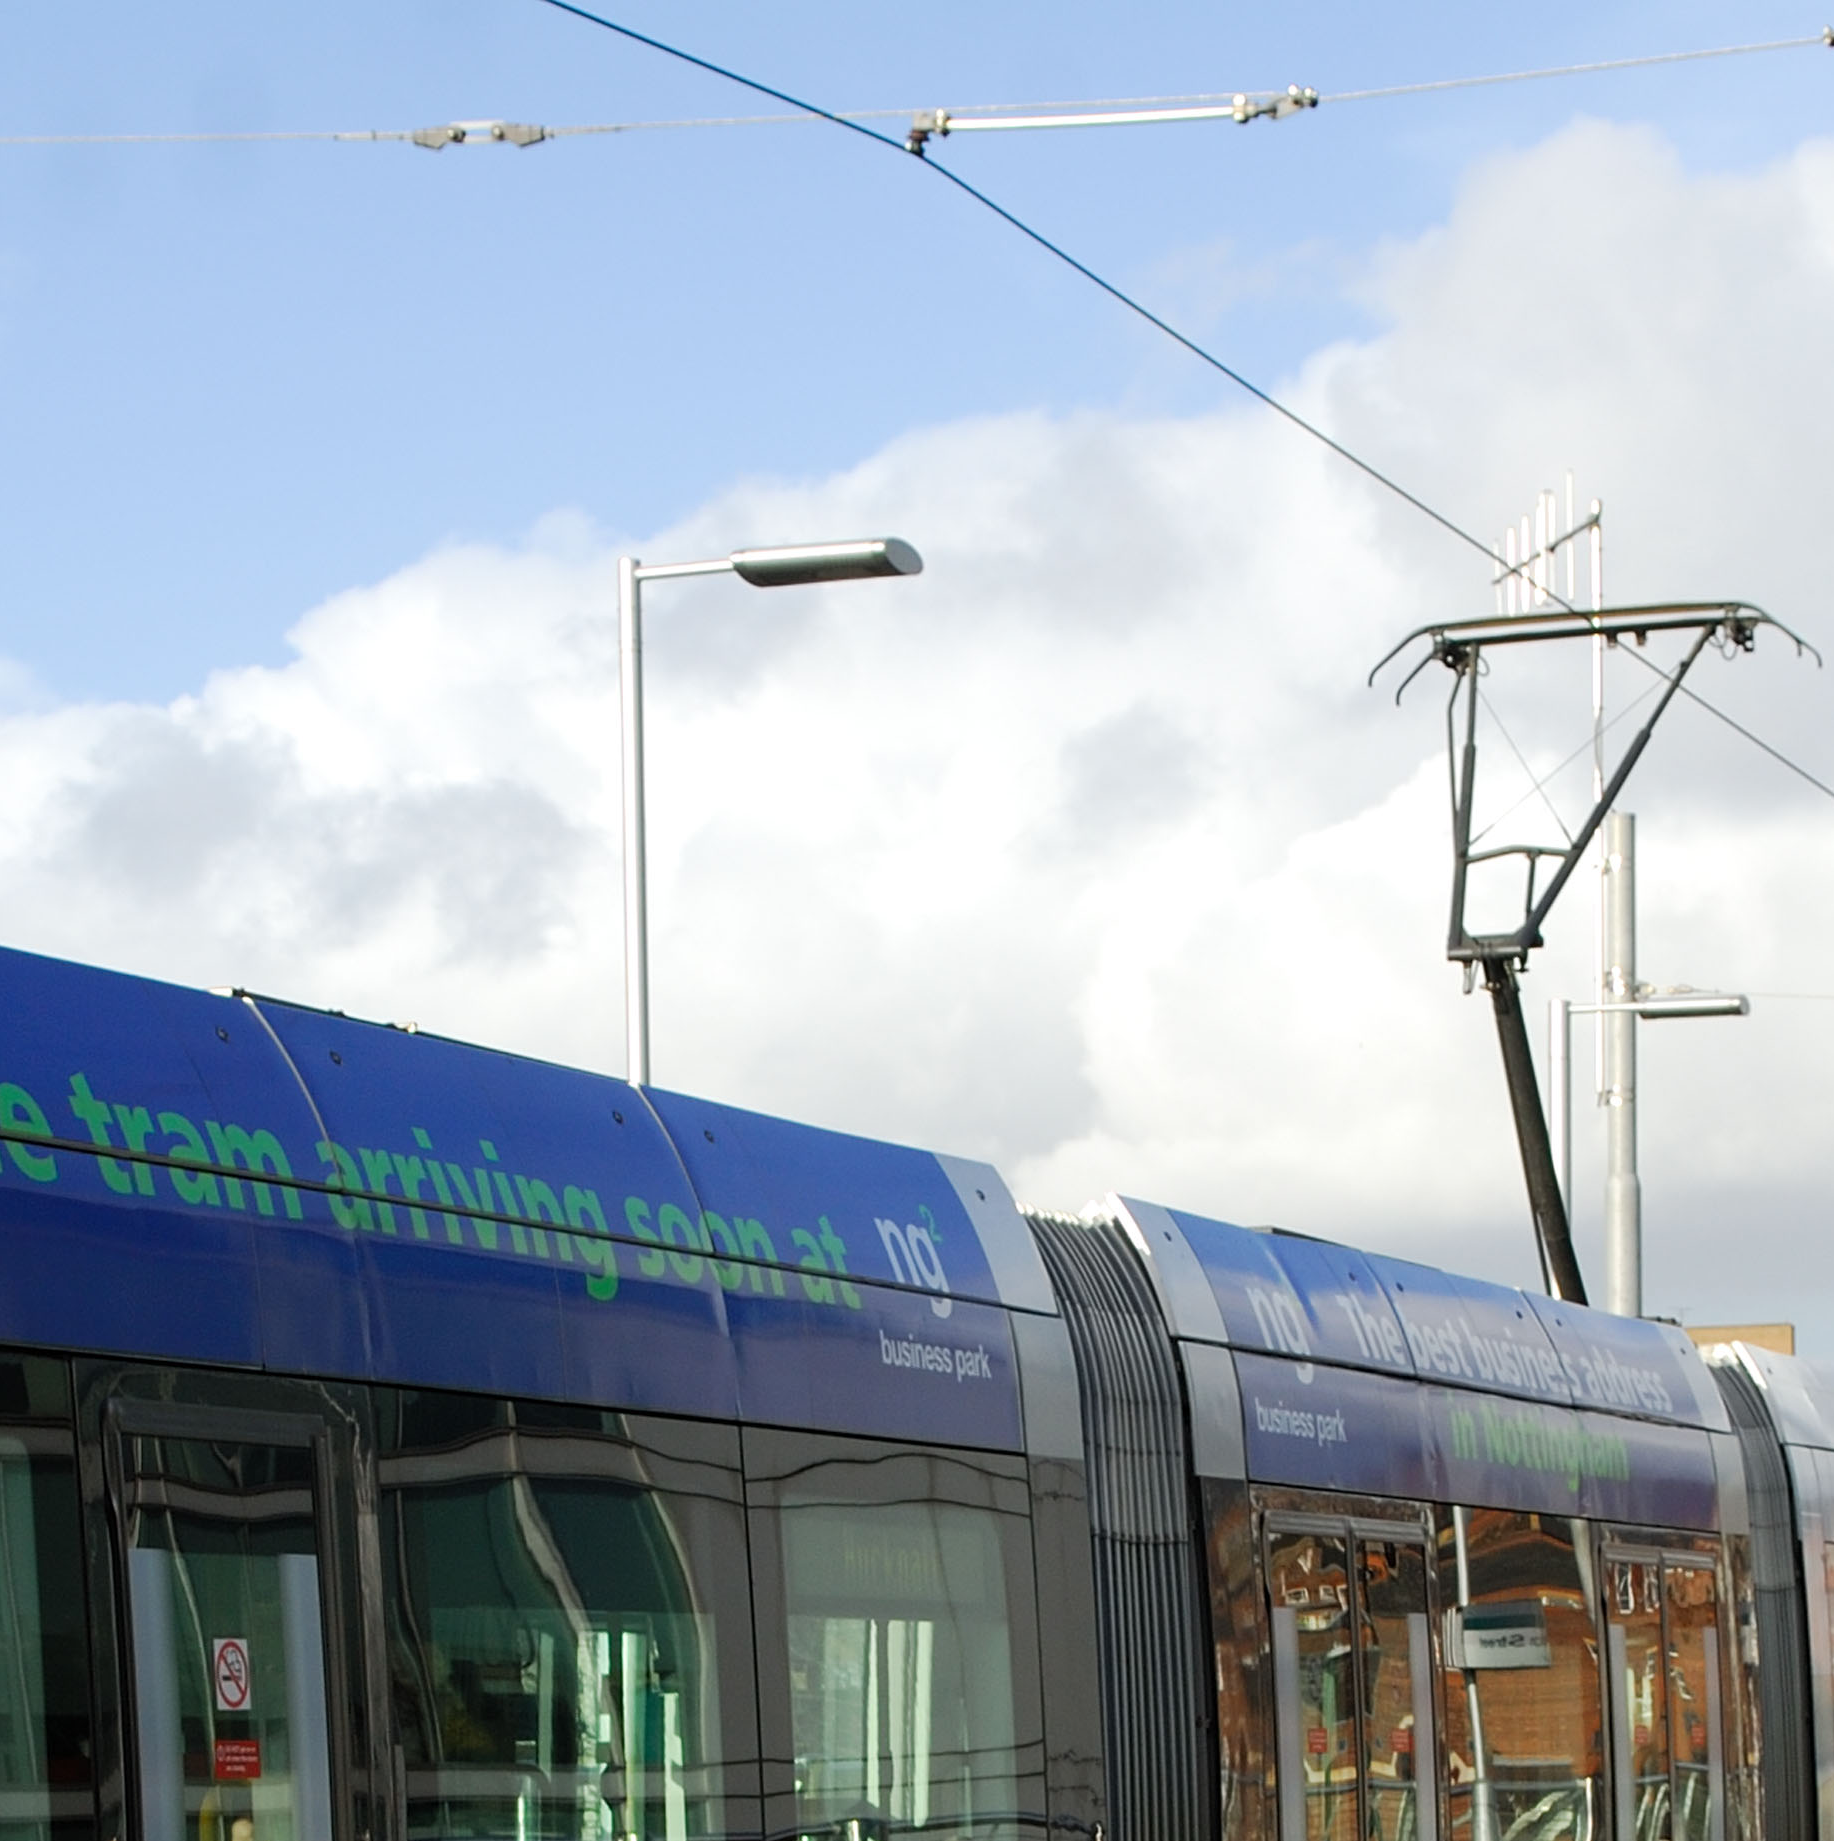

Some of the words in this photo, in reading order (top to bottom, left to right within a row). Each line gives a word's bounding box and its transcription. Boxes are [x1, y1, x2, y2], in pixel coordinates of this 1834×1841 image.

[68, 1072, 303, 1220] tram
[315, 1127, 620, 1301] arriving
[624, 1196, 786, 1298] soon
[790, 1215, 862, 1310] at
[879, 1328, 953, 1374] business
[954, 1343, 993, 1383] park
[1334, 1293, 1407, 1366] The
[1397, 1300, 1474, 1379] best
[1458, 1316, 1583, 1397] business
[1578, 1345, 1674, 1413] address
[1254, 1396, 1316, 1439] business
[1316, 1408, 1348, 1448] park
[1446, 1389, 1480, 1460] in
[1479, 1399, 1630, 1494] Nottingham
